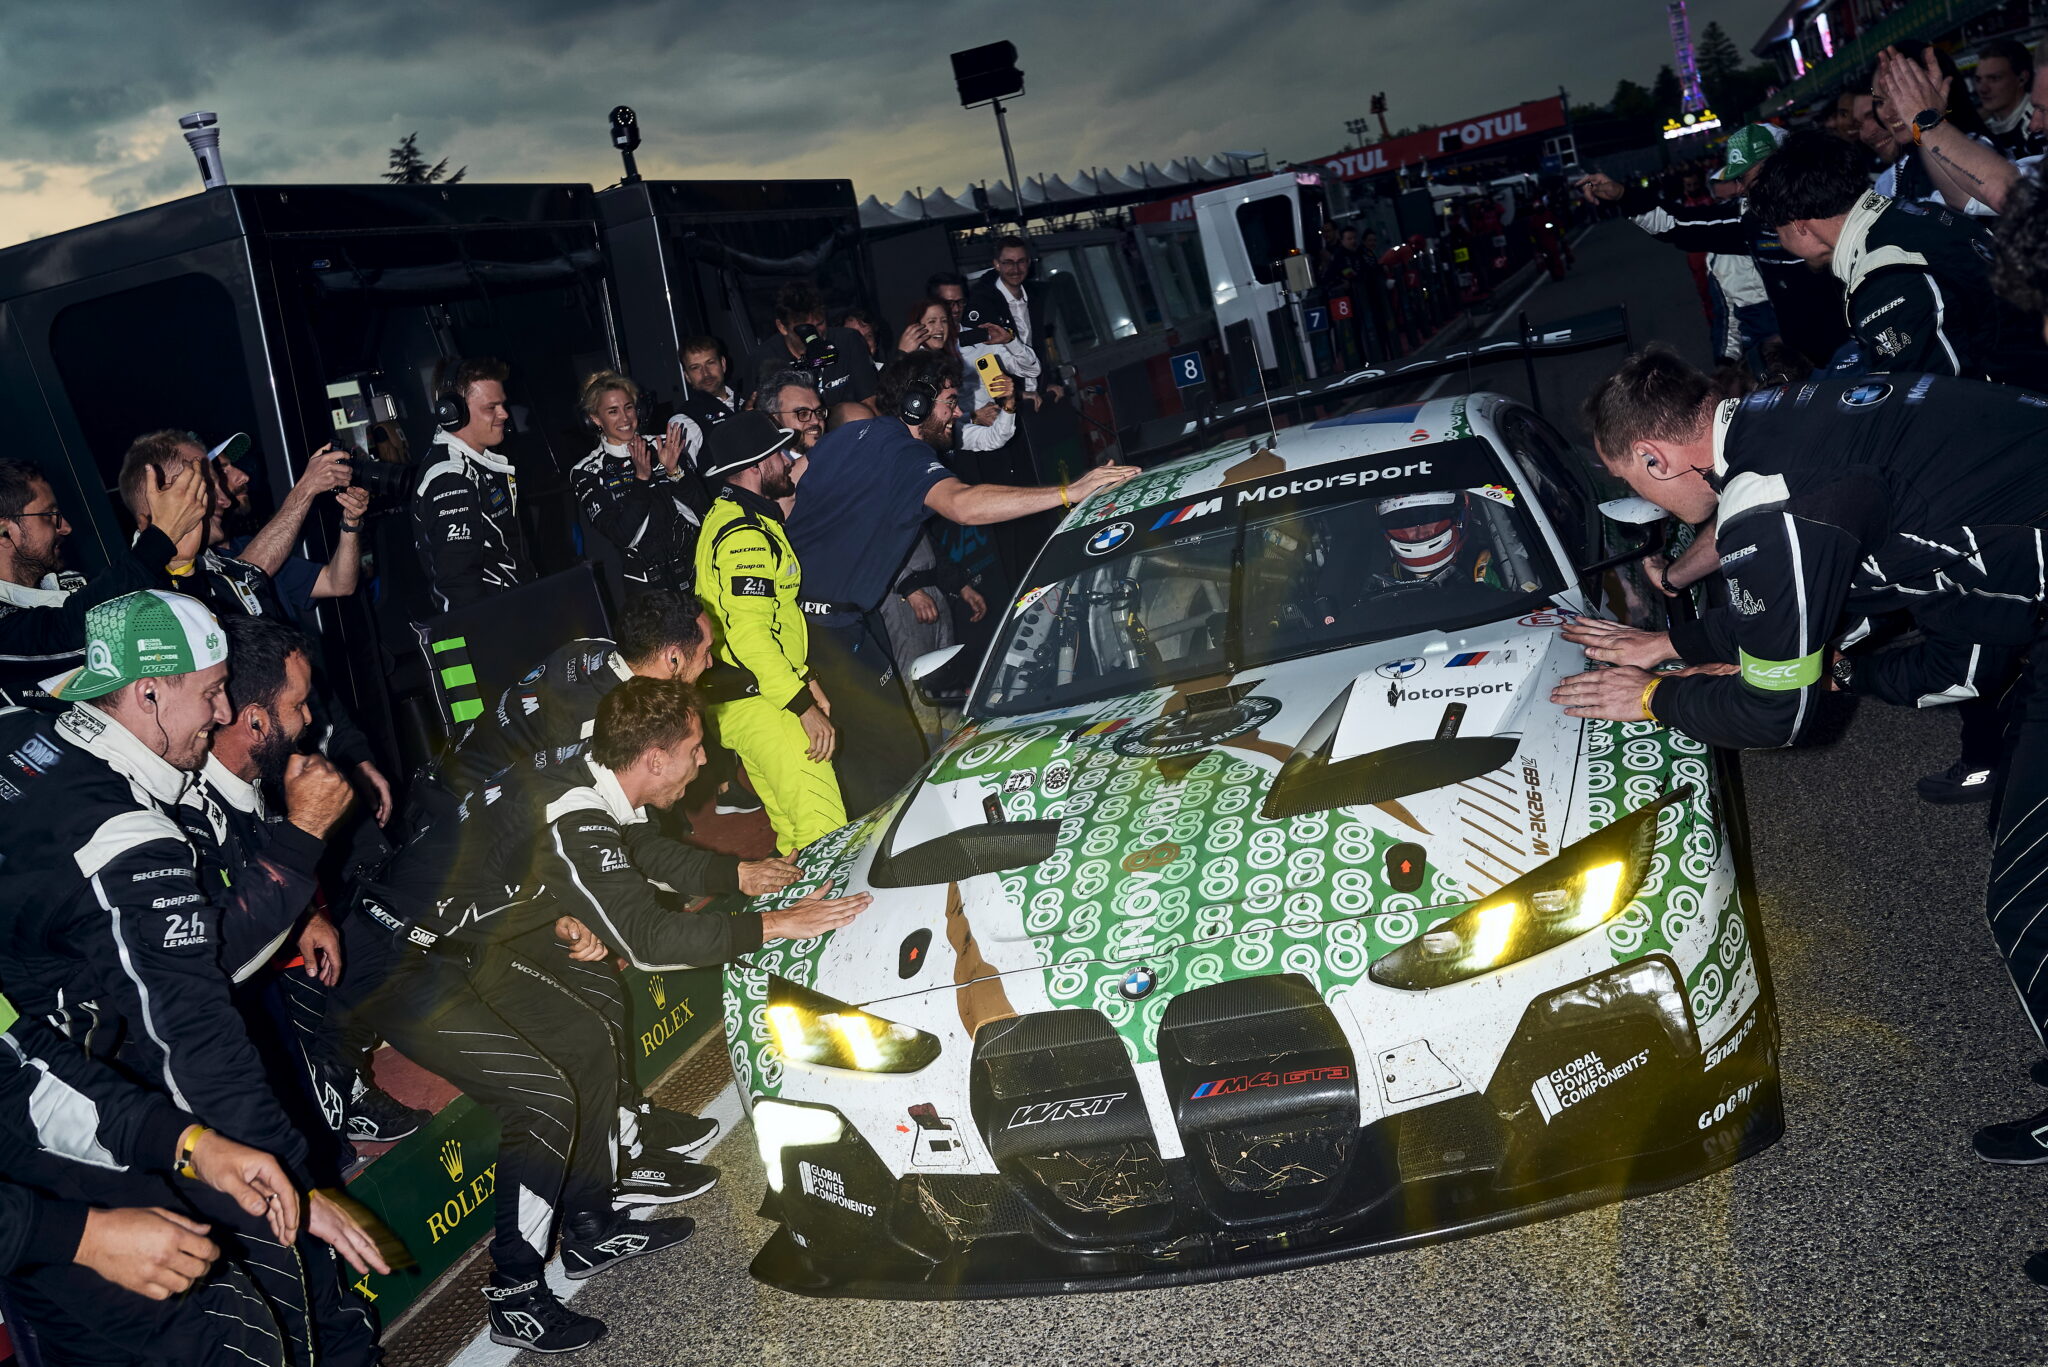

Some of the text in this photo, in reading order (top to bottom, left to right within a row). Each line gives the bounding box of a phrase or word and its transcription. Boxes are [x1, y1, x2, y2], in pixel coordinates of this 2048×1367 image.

[1338, 301, 1349, 315] 8
[1310, 311, 1321, 328] 7
[1184, 358, 1199, 380] 8
[1237, 460, 1433, 507] Motorsport
[447, 523, 471, 538] 24h
[729, 547, 767, 555] SKECHERS
[735, 563, 766, 571] Snap-on
[743, 577, 766, 592] 24h
[1387, 682, 1513, 702] Motorsport
[1210, 714, 1268, 743] RACING
[600, 847, 628, 867] 24h
[164, 911, 206, 940] 24h
[369, 904, 405, 929] WRT
[163, 938, 179, 949] LE
[410, 929, 437, 946] OMP
[640, 997, 695, 1058] ROLEX
[1284, 1065, 1350, 1086] GT3
[1550, 1050, 1602, 1084] GLOBAL
[1555, 1061, 1607, 1097] POWER
[1007, 1092, 1128, 1130] WRT
[631, 1170, 666, 1180] sparco
[810, 1164, 845, 1186] GLOBAL
[812, 1175, 846, 1197] POWER
